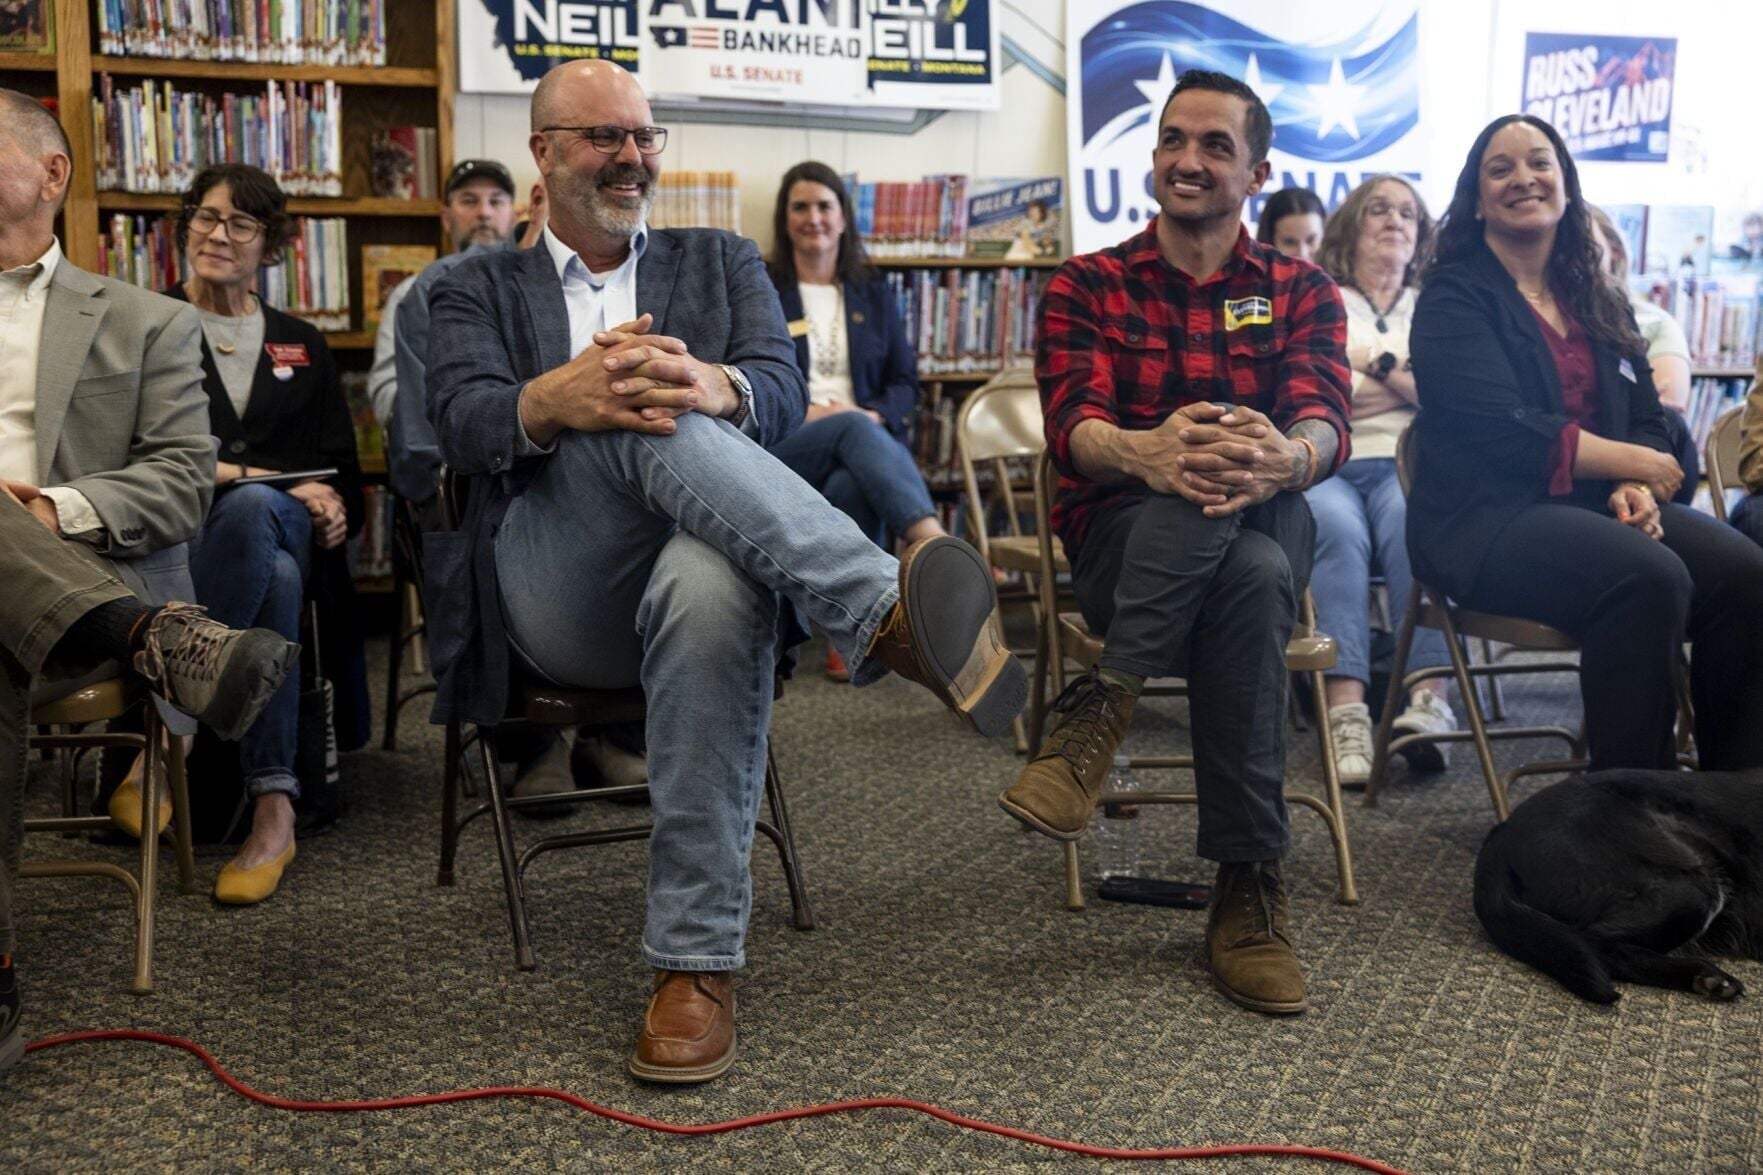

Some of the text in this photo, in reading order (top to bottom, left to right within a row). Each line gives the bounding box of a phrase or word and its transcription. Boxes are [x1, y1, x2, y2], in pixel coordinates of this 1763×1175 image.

[543, 45, 599, 58] SENATE
[724, 29, 861, 59] BANKHEAD
[709, 64, 804, 85] U.S. SENATE
[1526, 45, 1598, 100] RUSS
